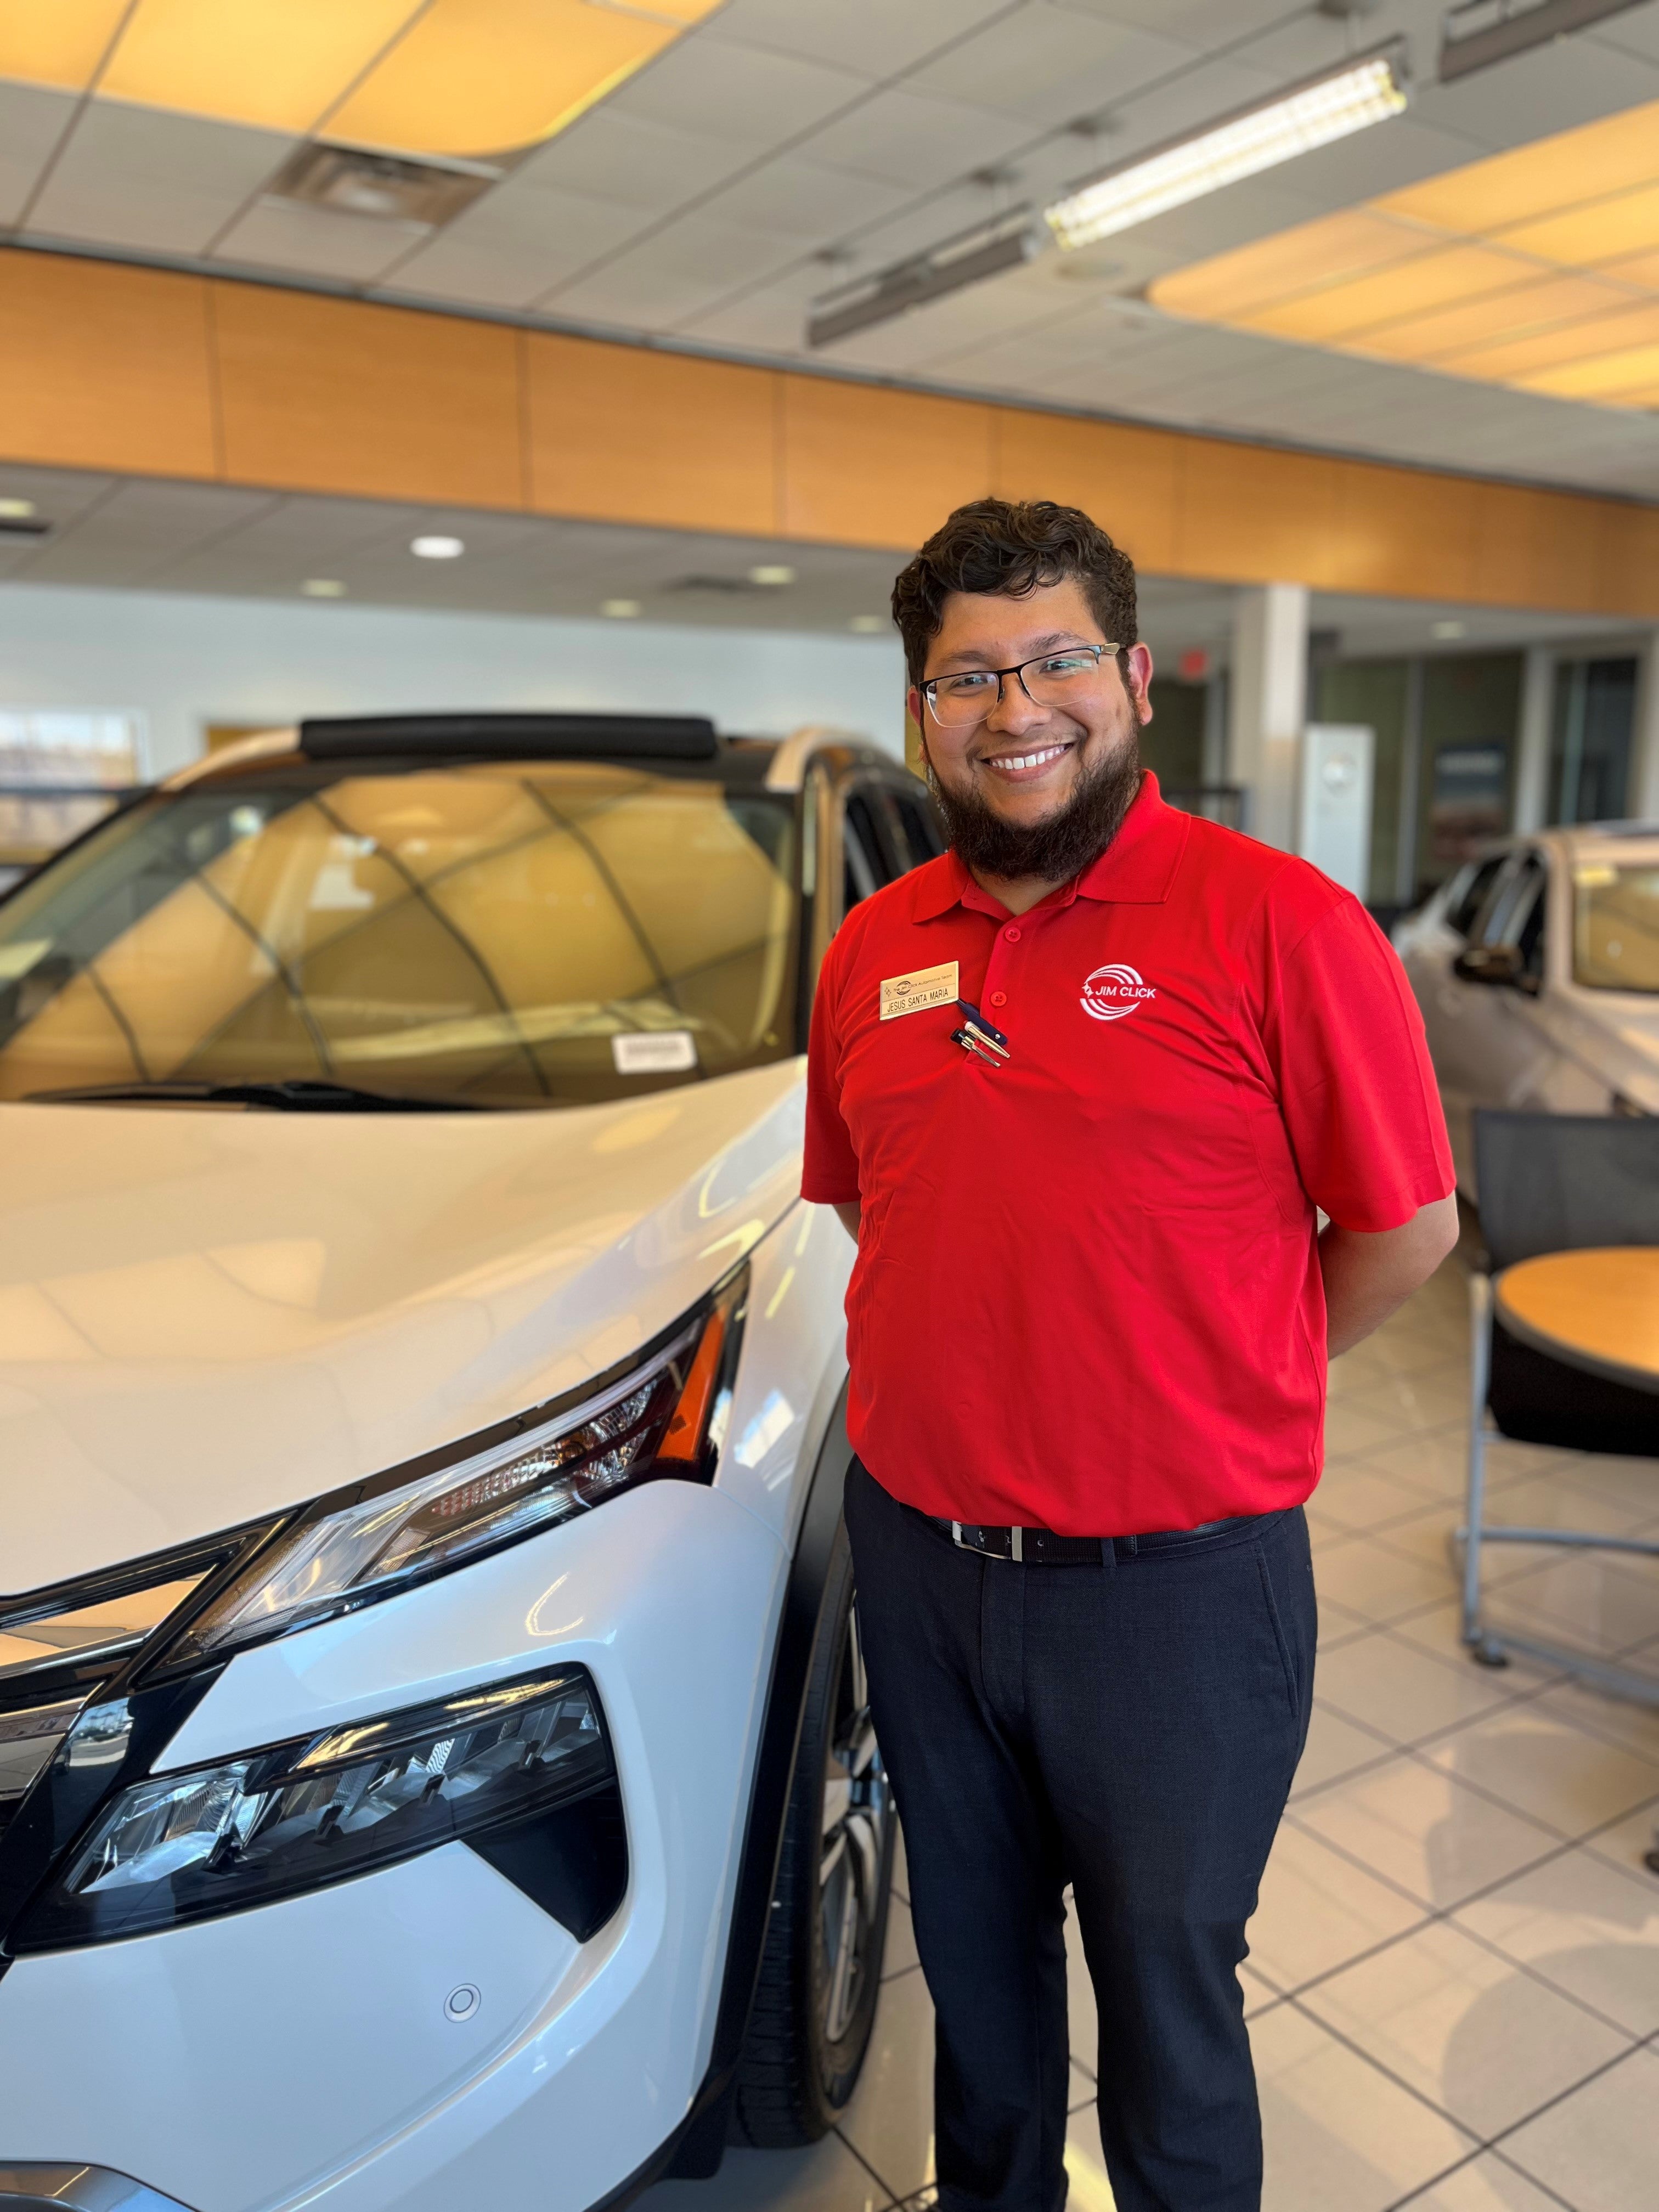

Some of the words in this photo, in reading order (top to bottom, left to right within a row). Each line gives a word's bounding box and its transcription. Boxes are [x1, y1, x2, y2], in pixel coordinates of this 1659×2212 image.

[887, 999, 906, 1012] JESUS
[908, 994, 927, 1007] SANTA
[930, 988, 949, 1001] MARIA
[1095, 986, 1117, 996] JIM
[1119, 986, 1156, 998] CLICK
